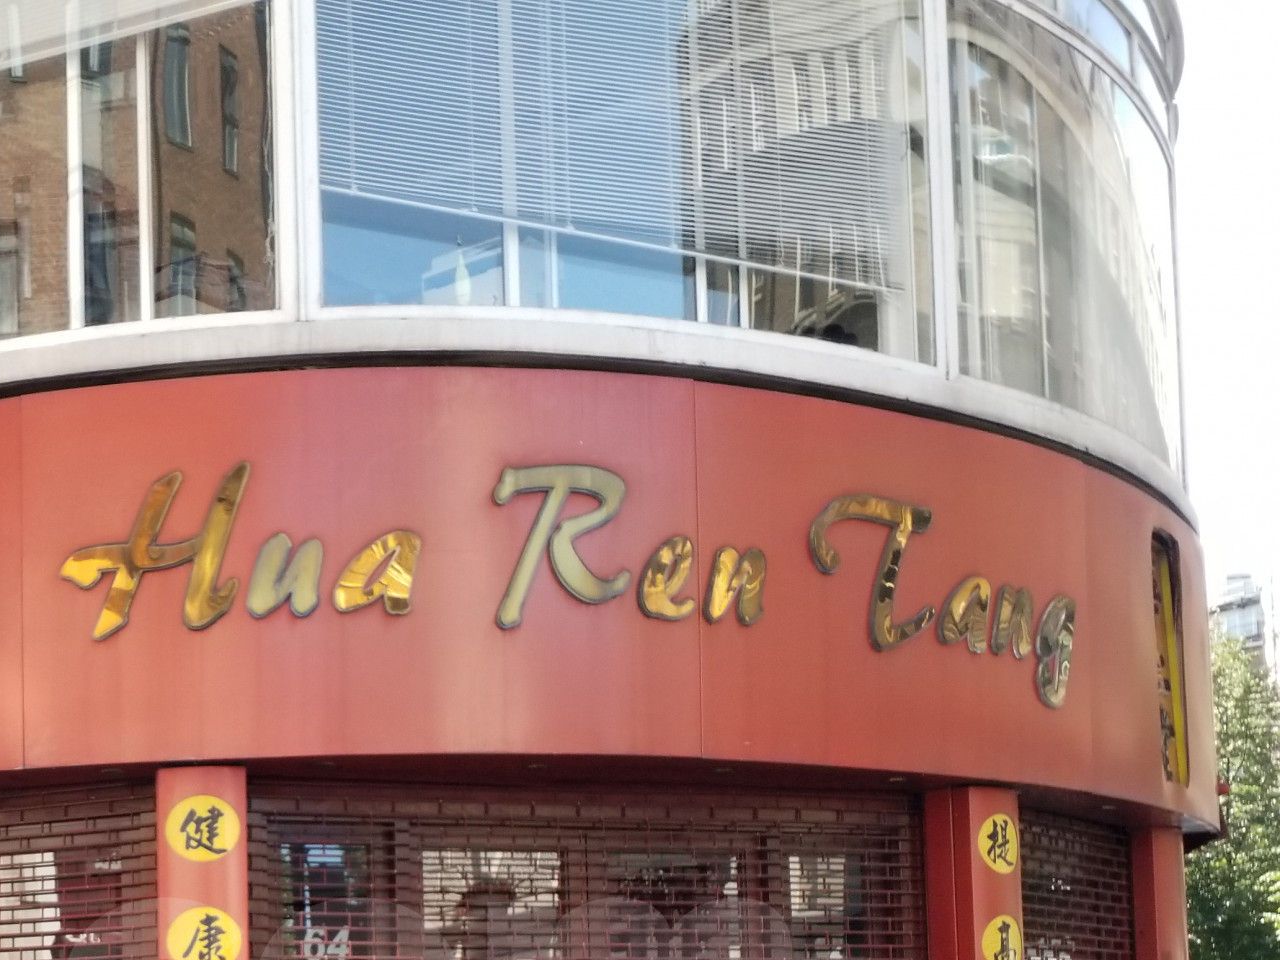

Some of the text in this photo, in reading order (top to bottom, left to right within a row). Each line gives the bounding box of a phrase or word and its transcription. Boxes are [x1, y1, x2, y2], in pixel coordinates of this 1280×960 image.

[58, 459, 422, 642] Hua
[492, 460, 769, 630] Ren
[805, 490, 1078, 709] Tang
